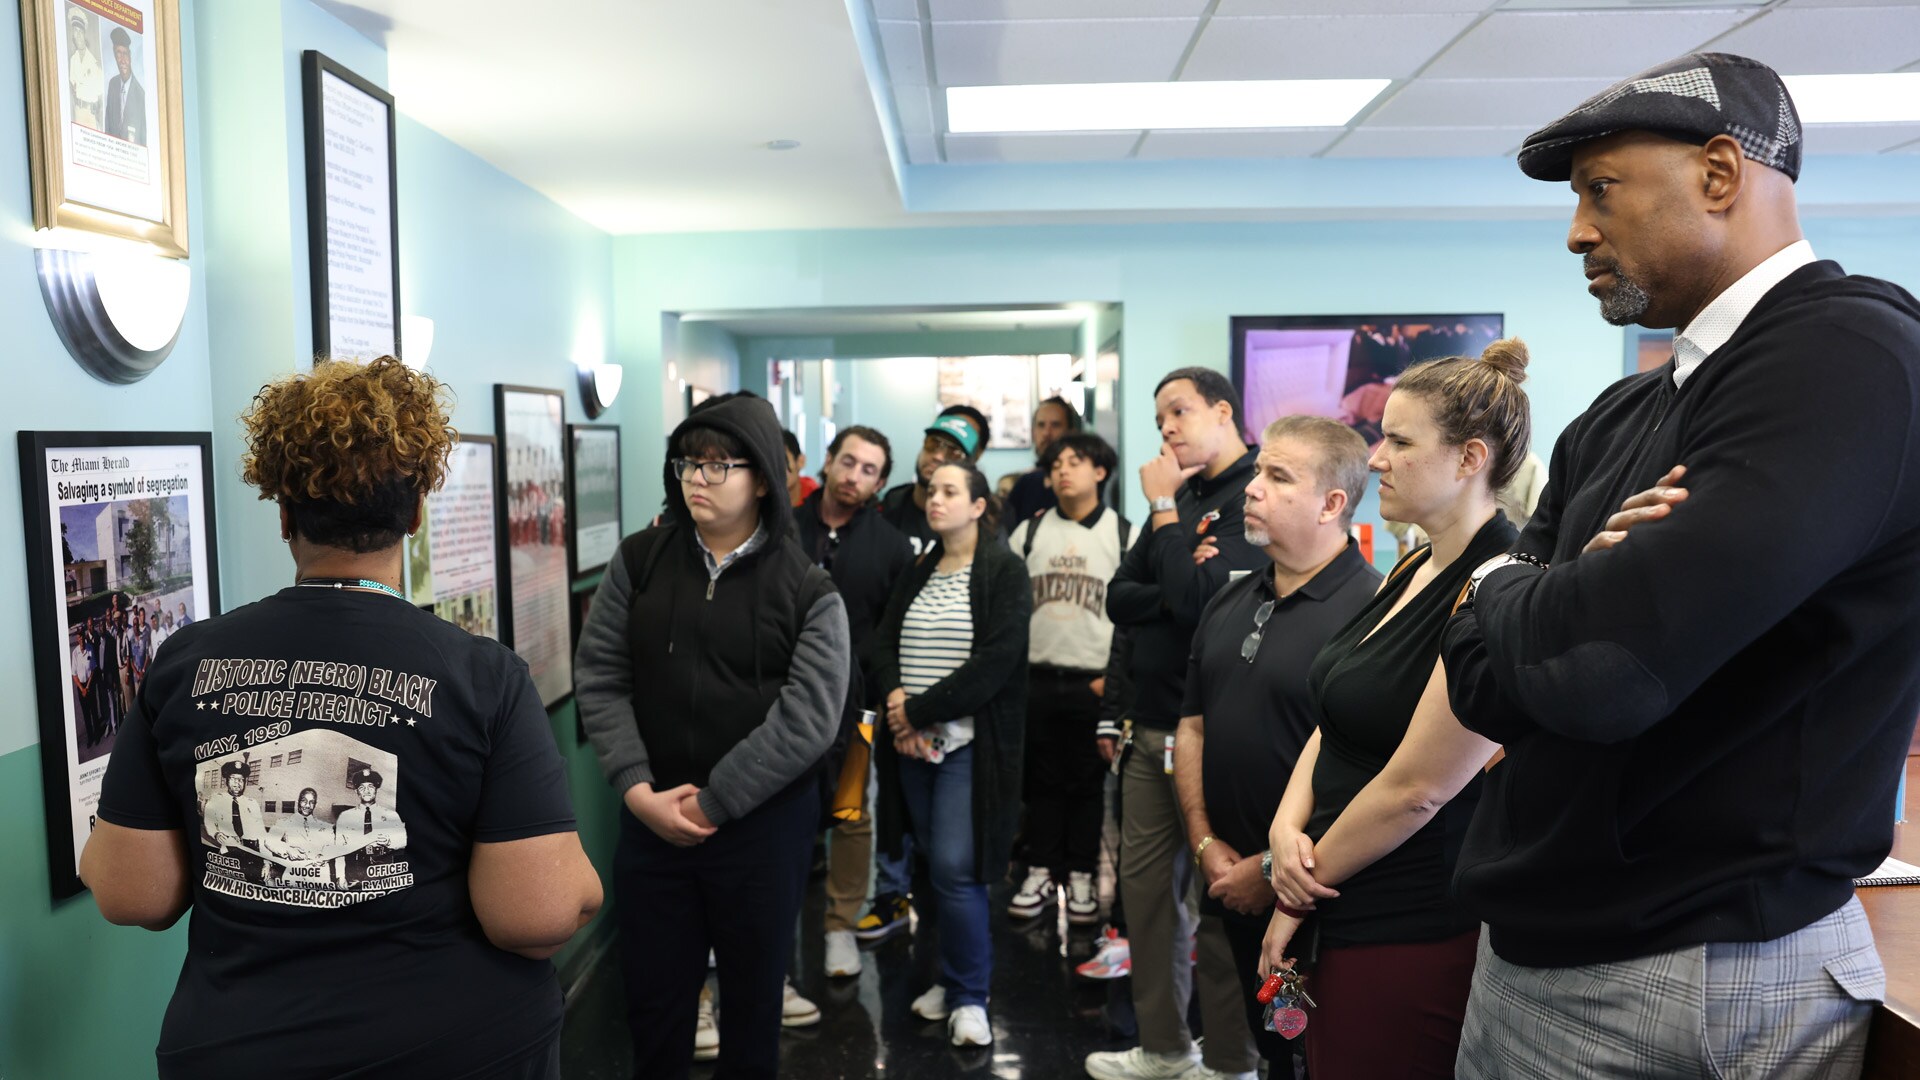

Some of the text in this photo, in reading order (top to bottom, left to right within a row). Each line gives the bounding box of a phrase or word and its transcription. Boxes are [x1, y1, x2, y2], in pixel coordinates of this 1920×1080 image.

[51, 456, 130, 474] The Miami Herald
[57, 474, 189, 503] Salvaging a symbol of segregation
[192, 658, 437, 718] HISTORIC (NEGRO) BLACK
[222, 691, 391, 727] POLICE PRECINCT
[194, 720, 292, 760] MAY, 1950
[207, 851, 241, 869] OFFICER
[289, 867, 321, 878] JUDGE
[366, 862, 409, 877] OFFICER
[295, 880, 336, 890] THOMAS
[382, 873, 414, 888] WHITE
